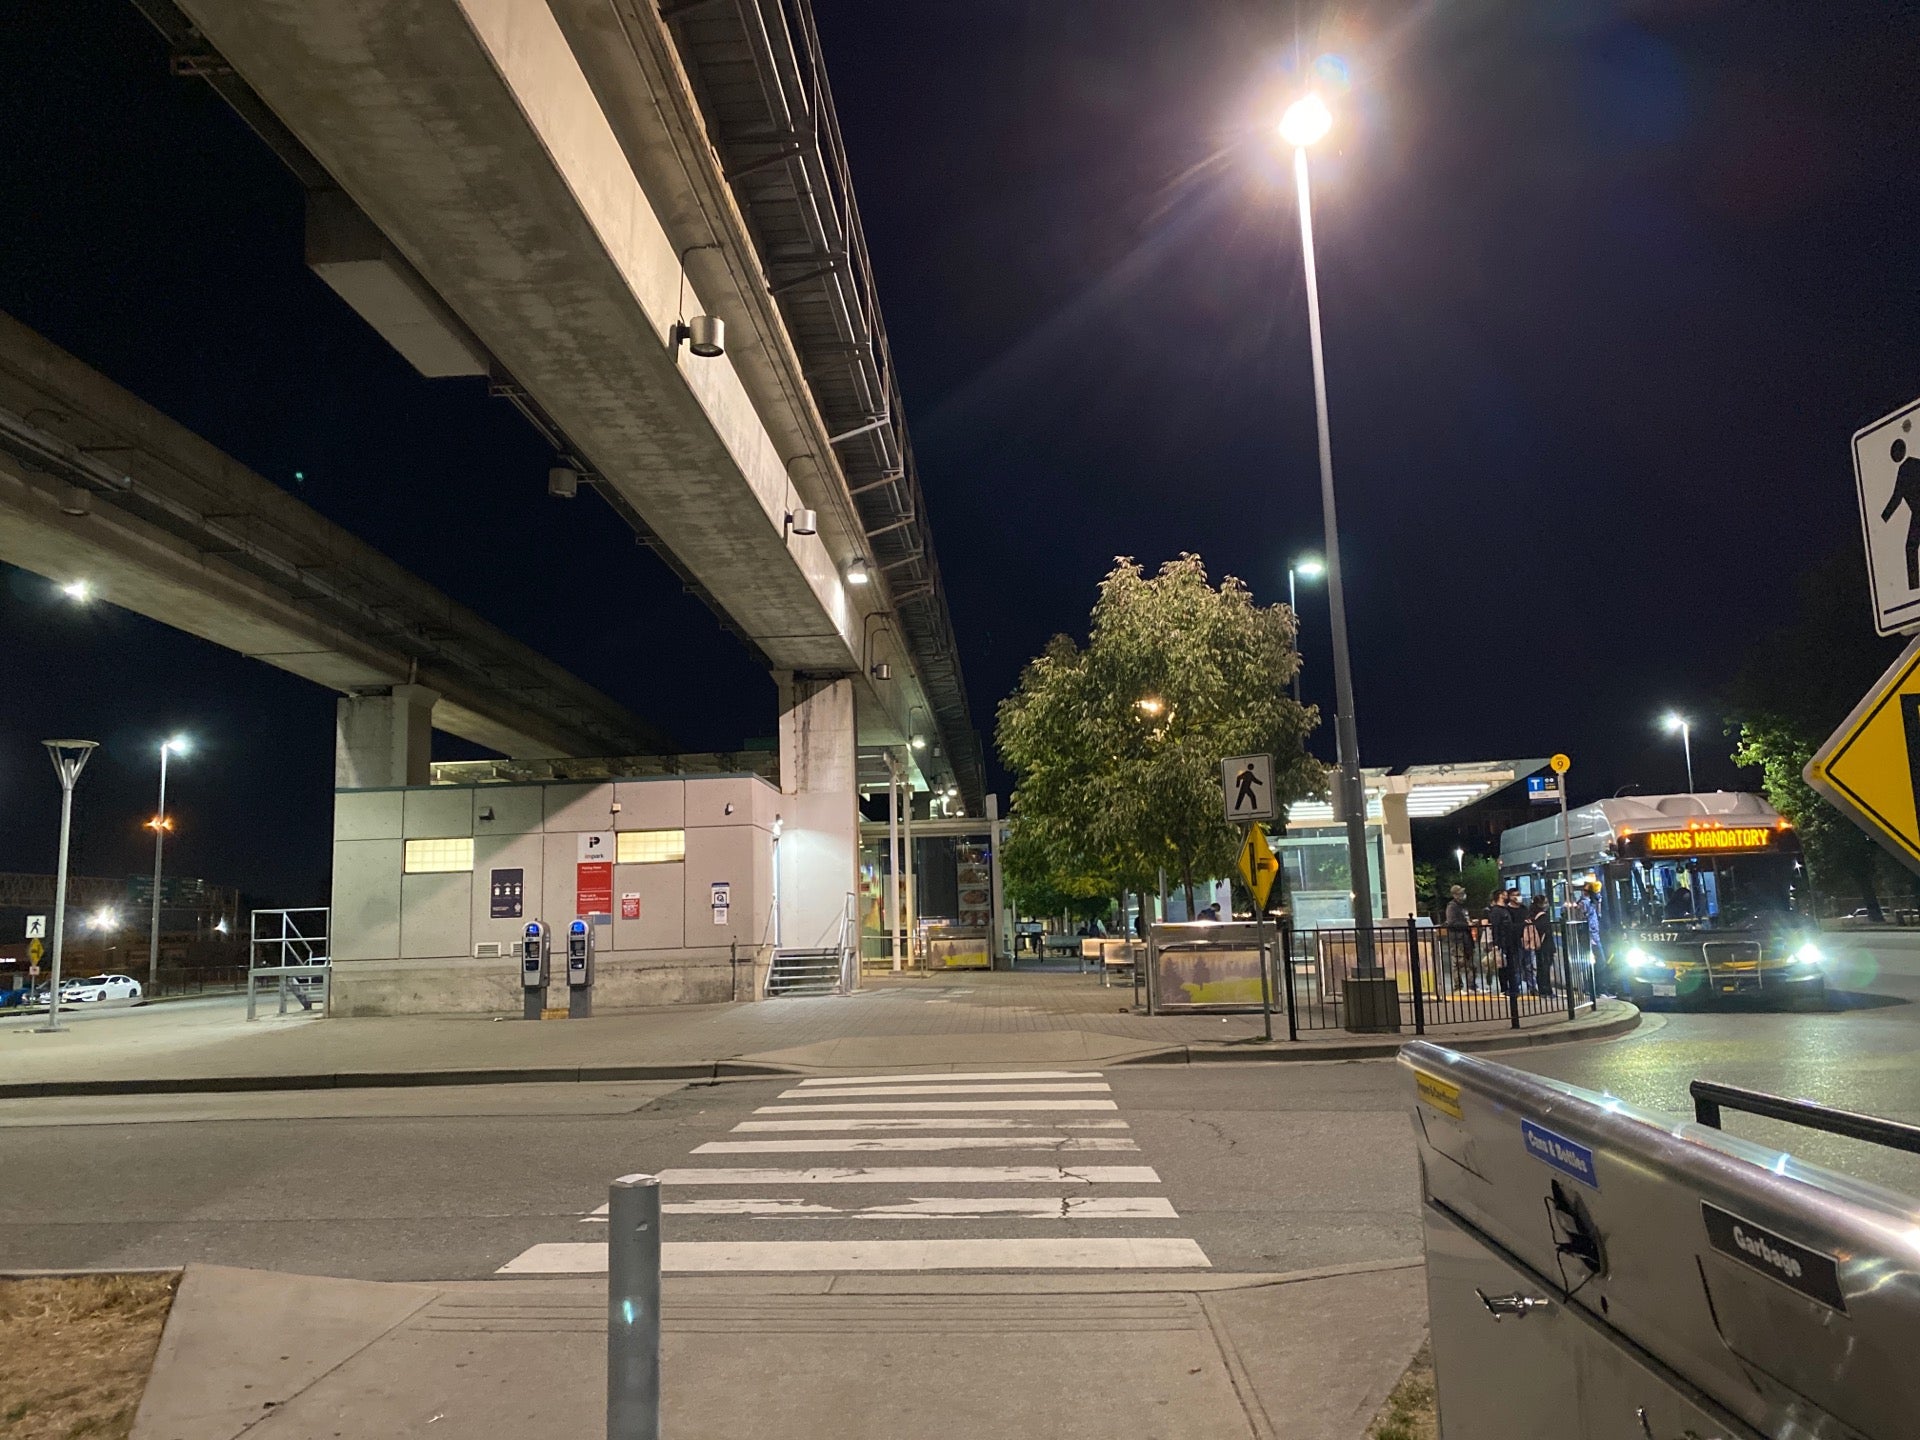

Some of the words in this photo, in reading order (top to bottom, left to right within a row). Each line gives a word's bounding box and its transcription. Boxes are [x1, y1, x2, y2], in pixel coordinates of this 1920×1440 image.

[1557, 760, 1564, 770] 9
[1530, 779, 1540, 790] T
[1650, 831, 1692, 850] MASKS
[1694, 828, 1769, 848] MANDATORY
[1640, 932, 1679, 942] S18177
[1555, 1142, 1588, 1173] Bottles
[1733, 1225, 1802, 1278] Garbage
